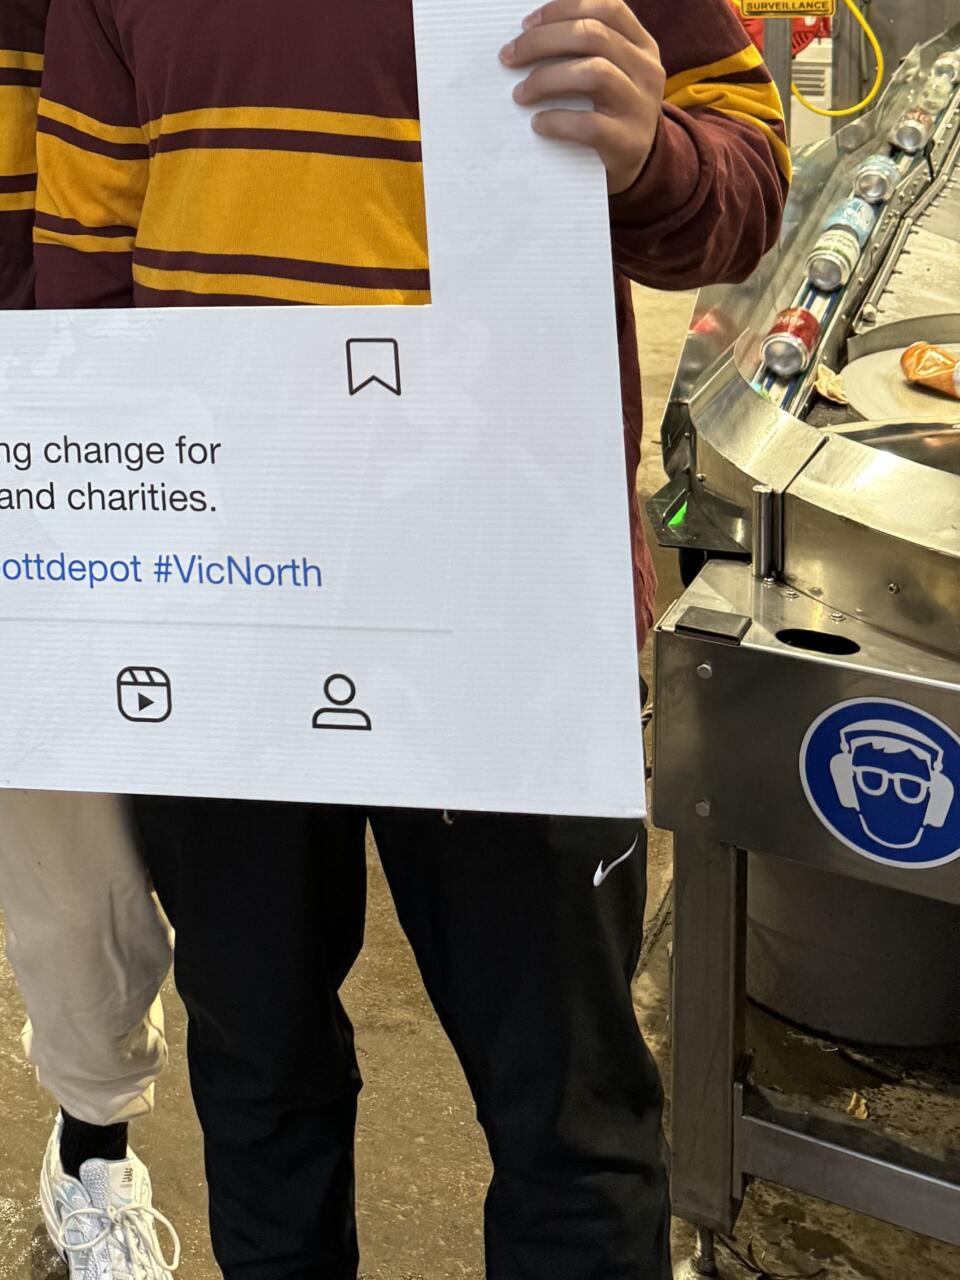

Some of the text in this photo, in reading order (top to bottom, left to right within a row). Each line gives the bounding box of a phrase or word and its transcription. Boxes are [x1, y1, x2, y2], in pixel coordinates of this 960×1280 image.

[747, 1, 829, 11] SURVEILLANCE
[43, 435, 165, 471] change
[175, 436, 221, 464] for
[67, 483, 217, 512] charities.
[154, 555, 322, 587] #VicNorth
